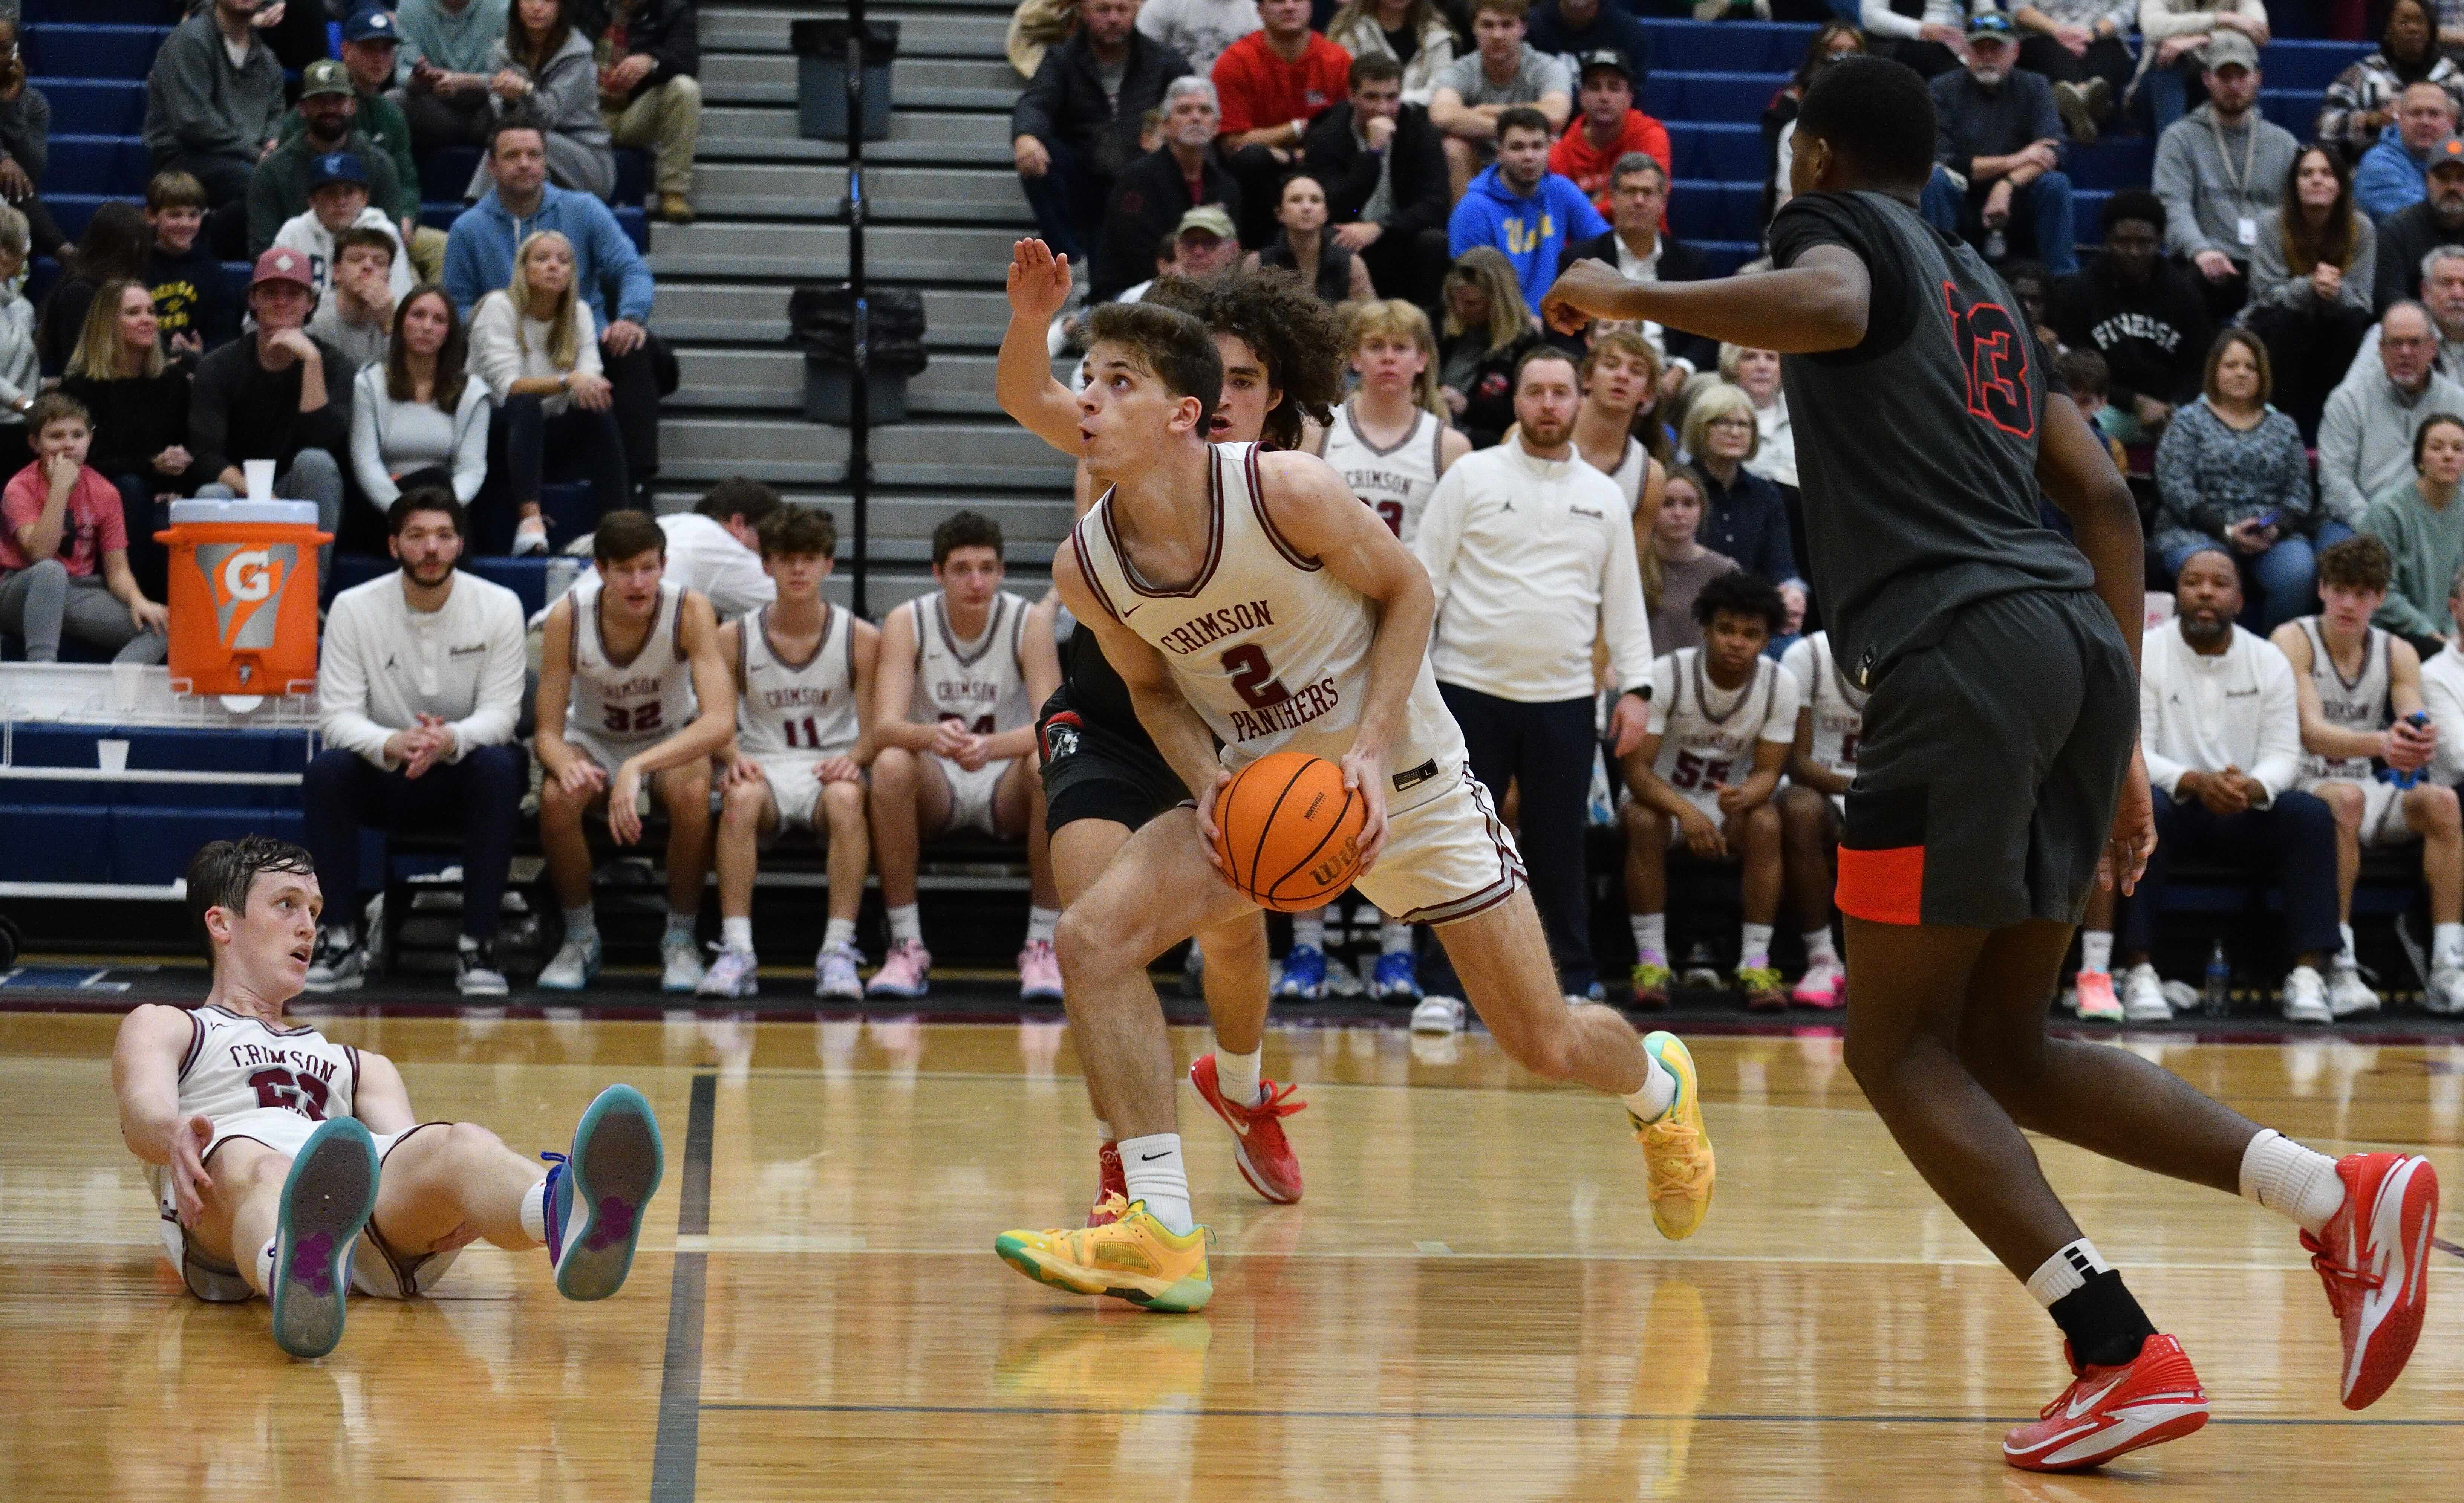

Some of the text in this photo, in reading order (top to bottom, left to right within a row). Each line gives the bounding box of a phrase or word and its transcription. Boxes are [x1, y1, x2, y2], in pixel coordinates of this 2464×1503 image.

[1942, 280, 2034, 440] 13
[225, 551, 270, 600] G
[1160, 599, 1274, 655] CRIMSON
[1218, 642, 1294, 711] 2
[603, 700, 663, 731] 32
[784, 716, 819, 748] 11
[1229, 677, 1339, 742] PANTHERS
[230, 1044, 337, 1083] CRIMSON
